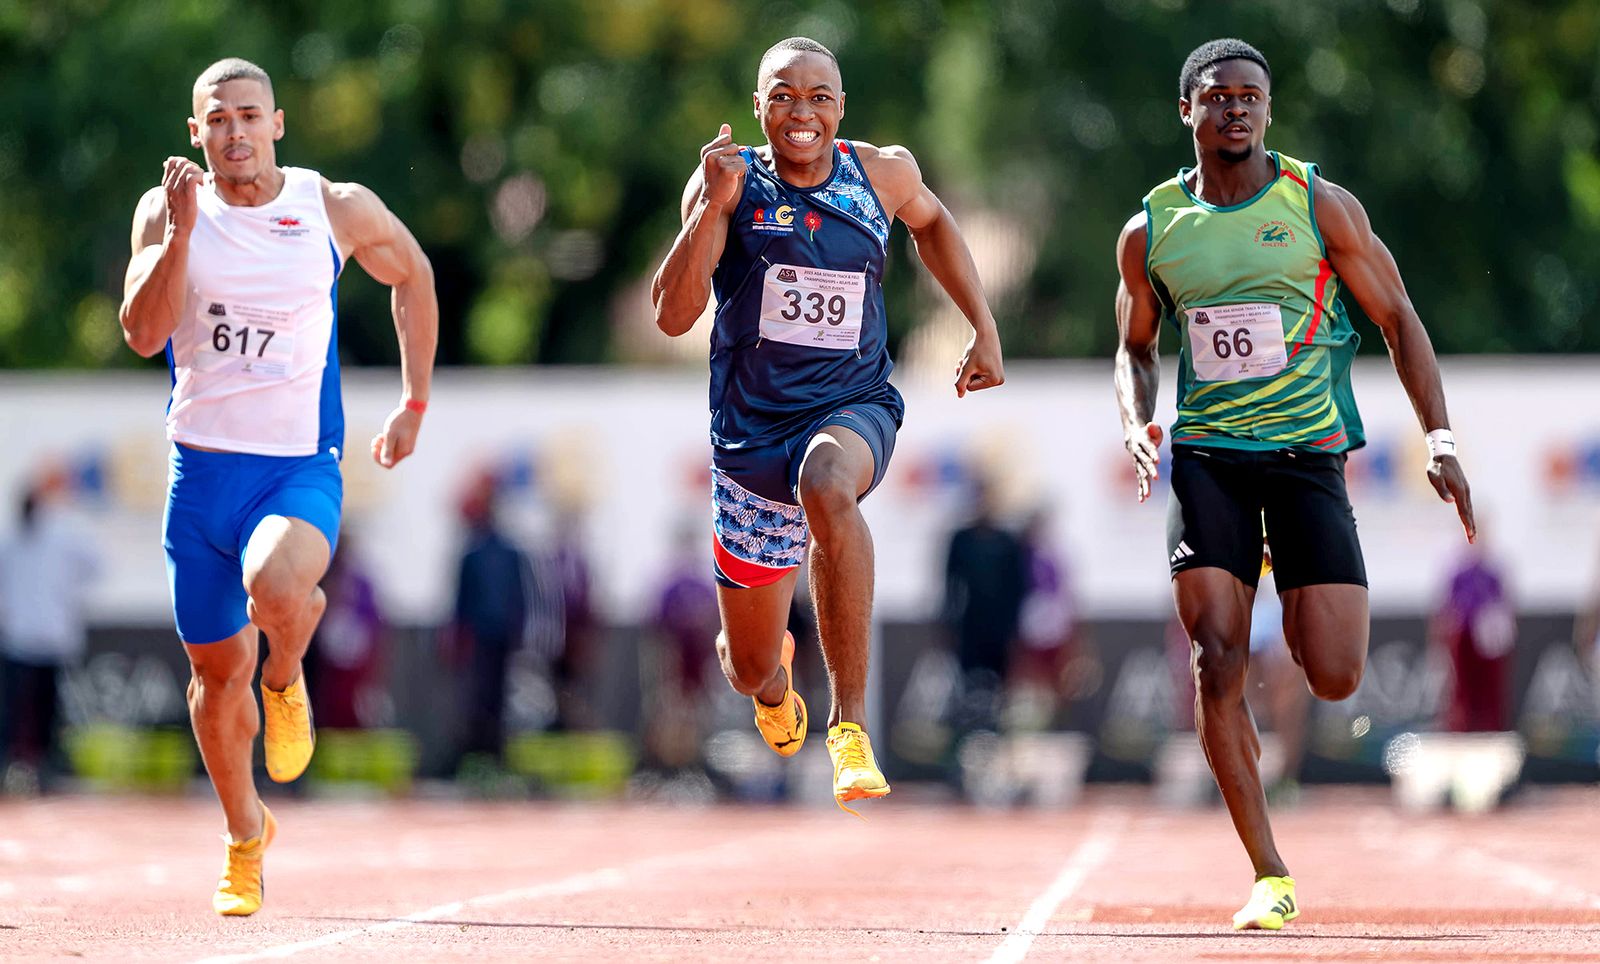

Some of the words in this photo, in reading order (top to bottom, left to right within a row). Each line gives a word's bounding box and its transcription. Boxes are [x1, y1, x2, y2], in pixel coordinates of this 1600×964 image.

[780, 289, 846, 326] 339
[212, 322, 275, 358] 617
[1212, 327, 1253, 359] 66
